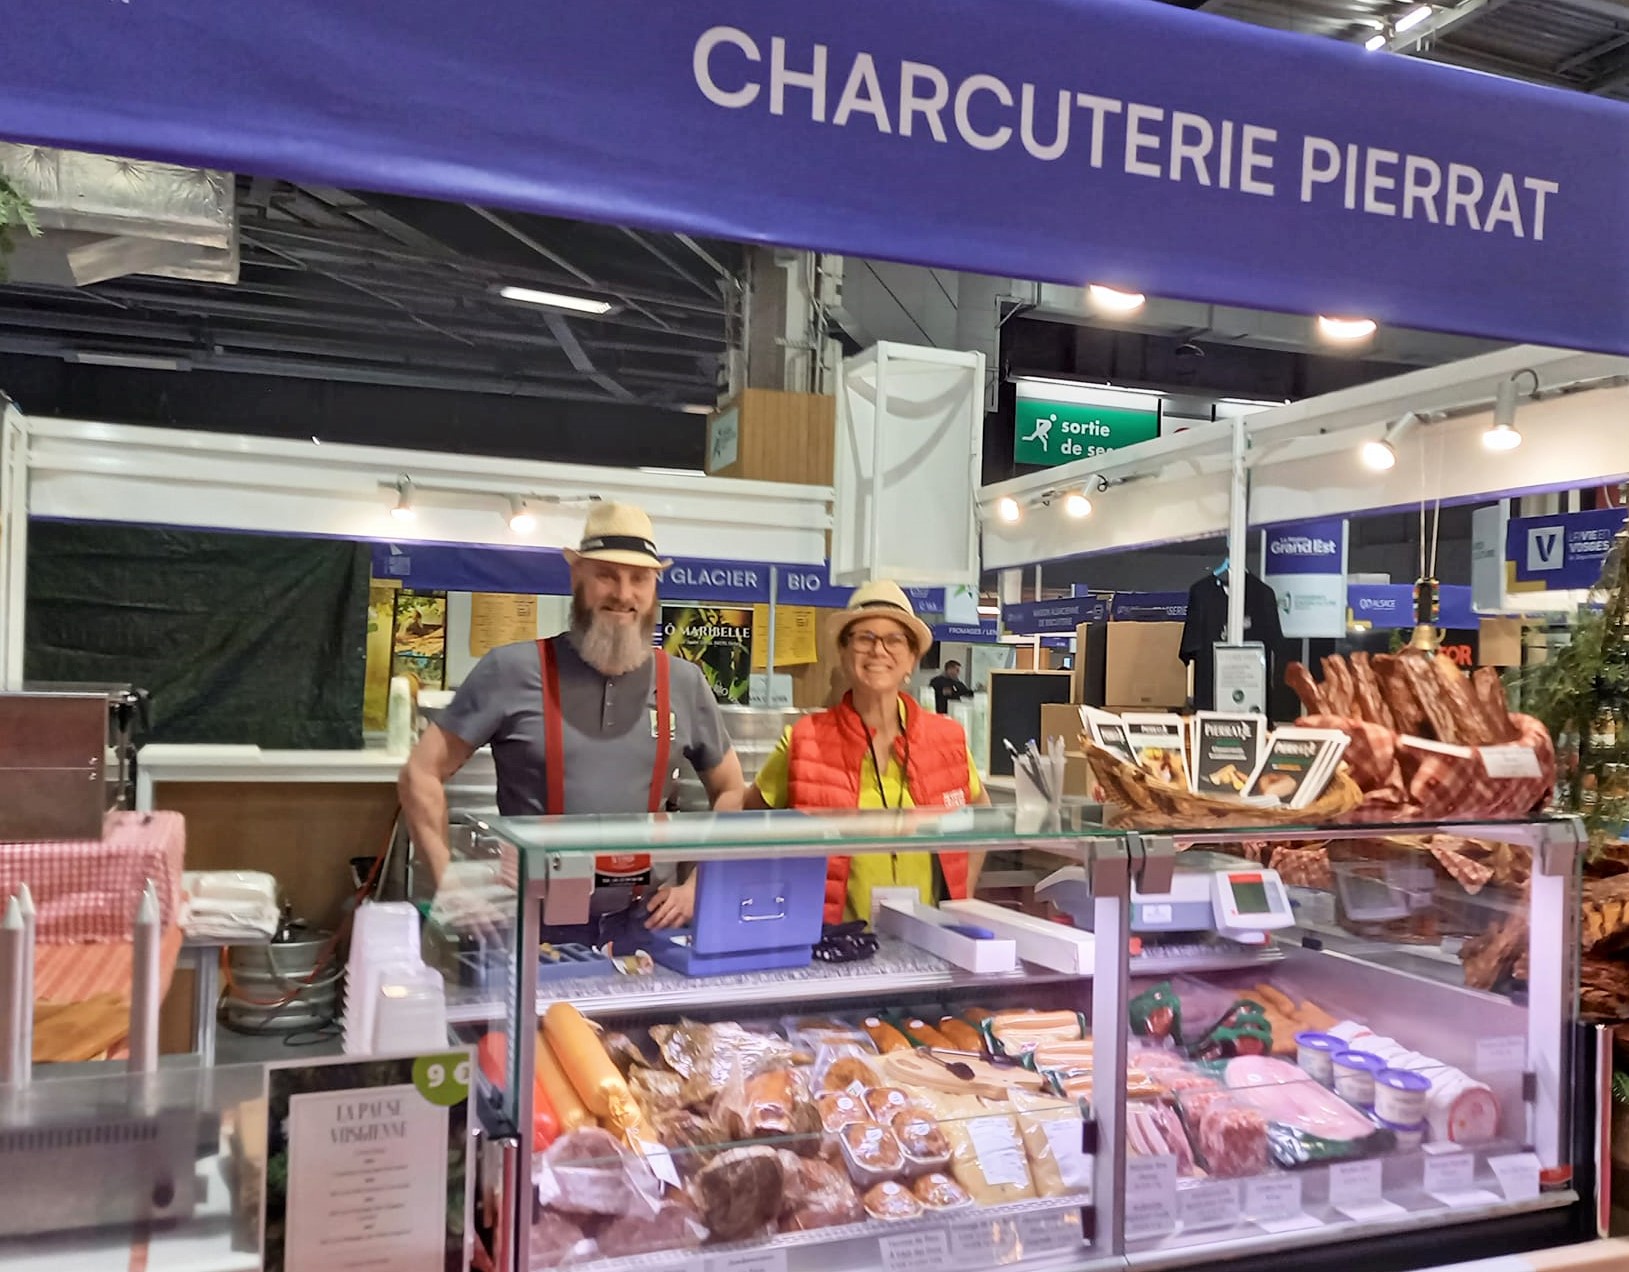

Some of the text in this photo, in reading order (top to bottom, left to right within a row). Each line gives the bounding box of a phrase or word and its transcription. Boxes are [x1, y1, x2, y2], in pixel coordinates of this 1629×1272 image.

[692, 25, 1560, 242] CHARCUTERIE PIERRAT
[1061, 420, 1111, 437] sortie
[1061, 438, 1083, 456] de
[1271, 539, 1336, 554] Grand Est
[1535, 534, 1556, 562] V
[671, 569, 758, 588] GLACIER
[788, 573, 821, 591] BIO
[664, 623, 751, 639] Ô MARIBELLE
[427, 1064, 445, 1087] 9
